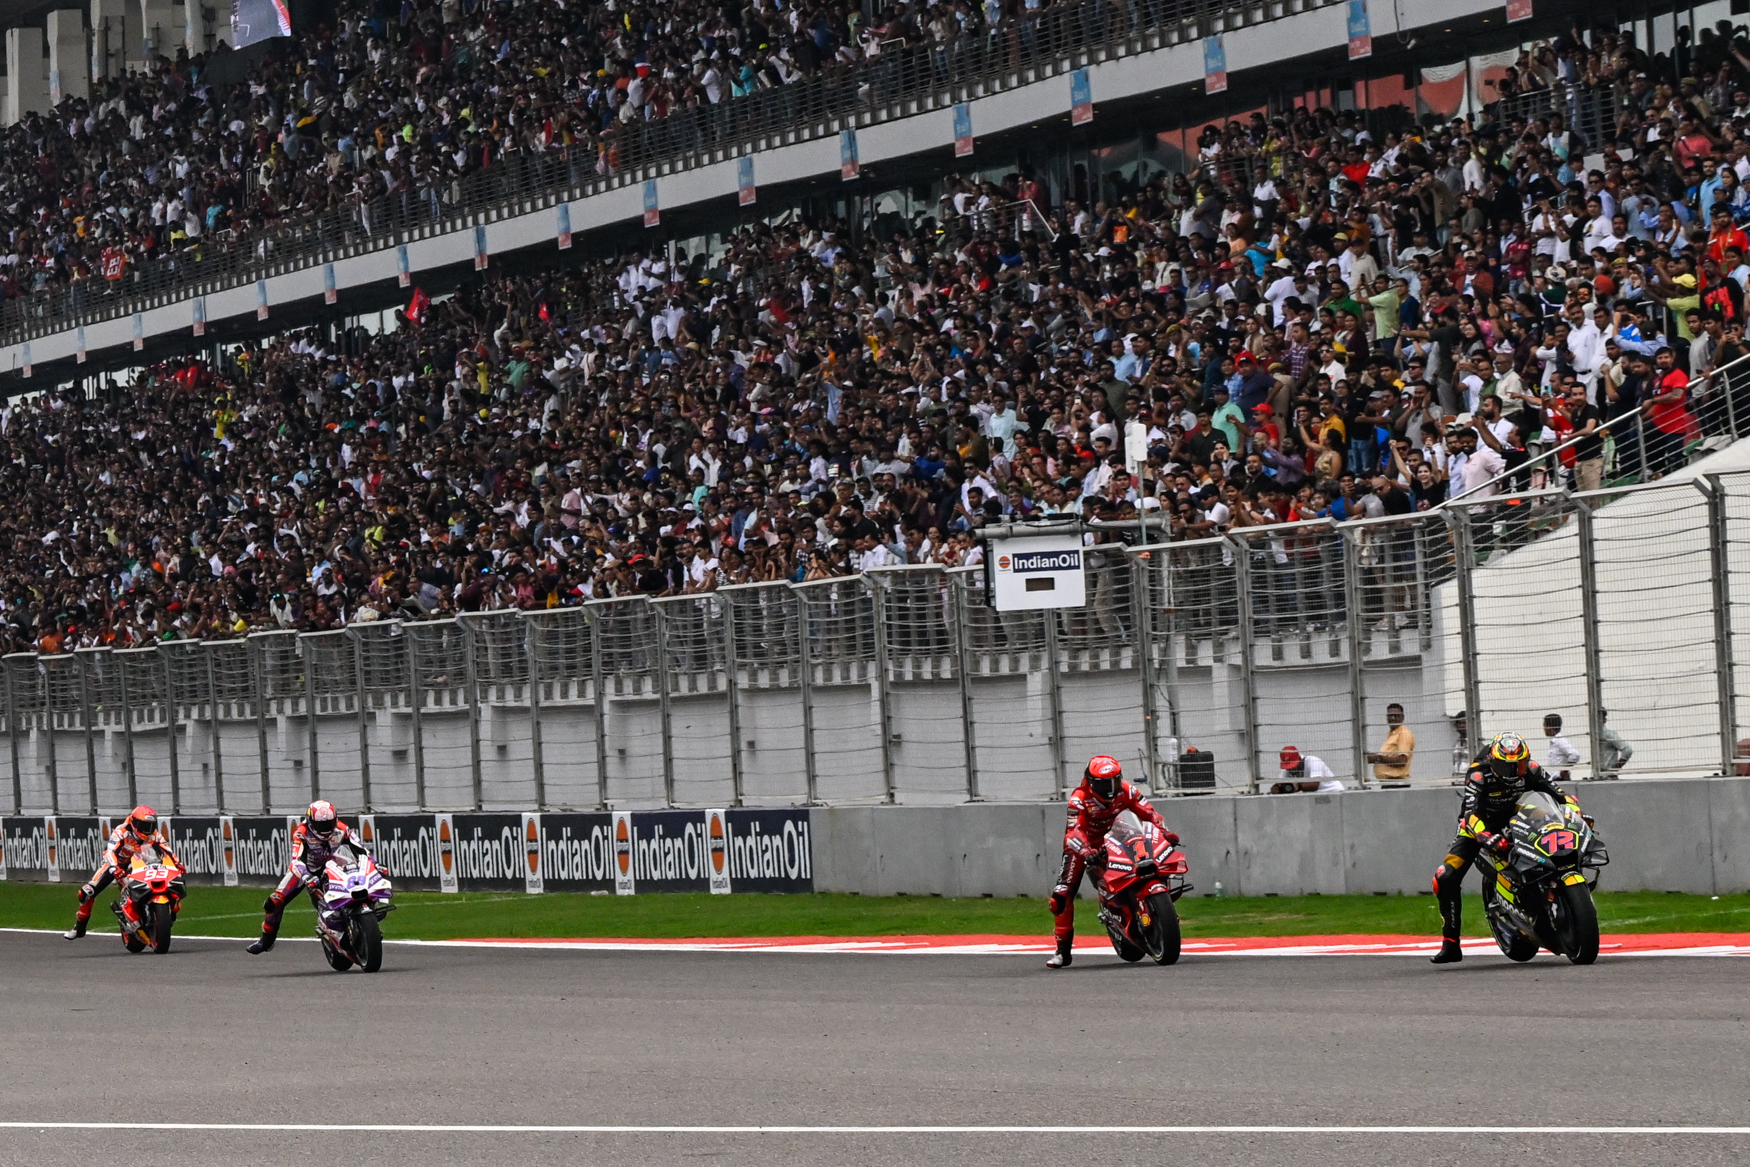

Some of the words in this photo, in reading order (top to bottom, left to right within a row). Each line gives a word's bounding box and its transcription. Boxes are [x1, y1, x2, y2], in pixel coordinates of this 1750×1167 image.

[1014, 554, 1079, 570] IndianOil
[3, 826, 48, 870] IndianOil
[56, 826, 102, 871] IndianOil
[172, 826, 224, 877] IndianOil
[235, 825, 292, 877] IndianOil
[376, 826, 440, 878] IndianOil
[455, 826, 525, 880] IndianOil
[542, 825, 615, 881] IndianOil
[633, 821, 709, 880] IndianOil
[728, 819, 811, 880] IndianOil
[1109, 862, 1133, 872] Lenovo
[144, 869, 168, 881] 93
